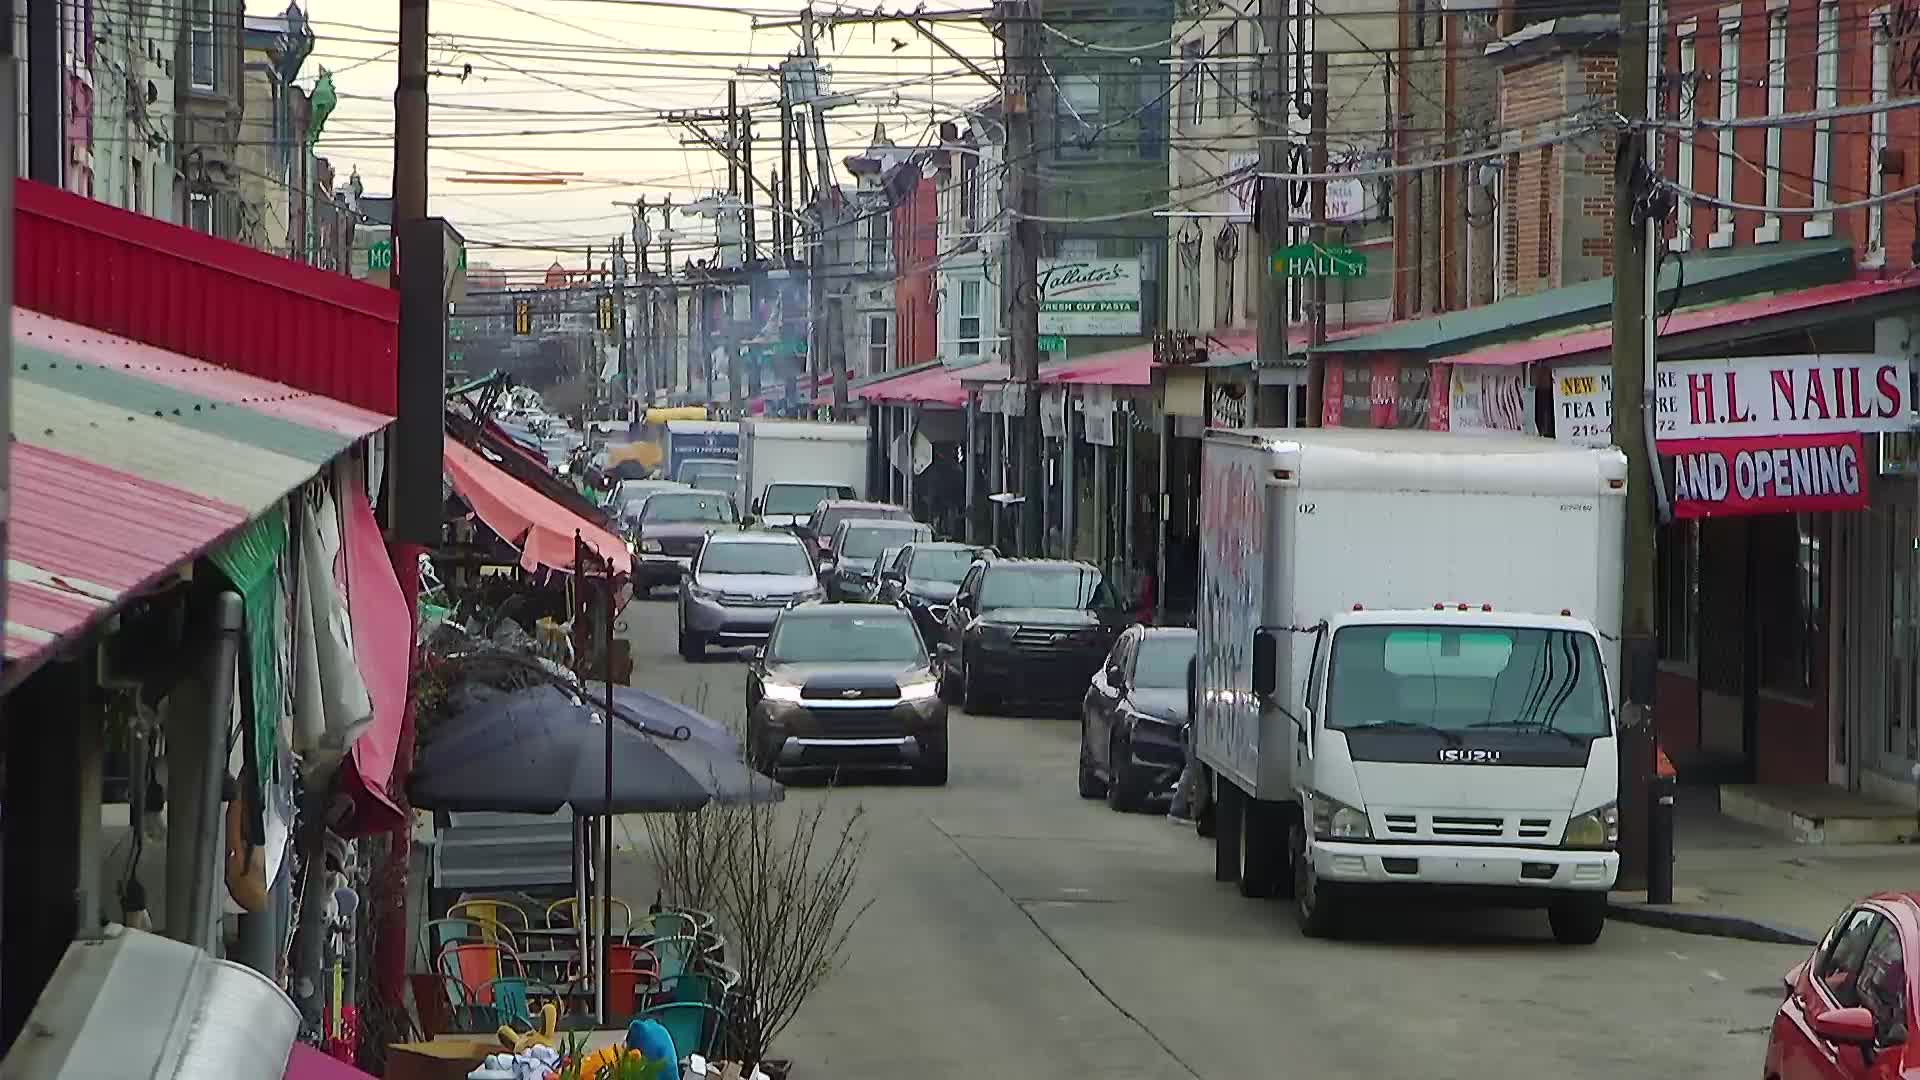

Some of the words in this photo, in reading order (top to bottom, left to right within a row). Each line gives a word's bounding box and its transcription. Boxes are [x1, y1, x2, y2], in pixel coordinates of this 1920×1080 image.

[1289, 256, 1340, 275] HALL
[1348, 262, 1363, 276] ST
[1076, 303, 1096, 311] CUT
[1100, 303, 1131, 311] PASTA
[1563, 376, 1594, 395] NEW
[1687, 371, 1757, 425] H.L.
[1769, 365, 1902, 421] NAILS
[1561, 401, 1596, 419] TEA
[1735, 444, 1860, 500] OPENING
[1439, 749, 1500, 763] ISUZU
